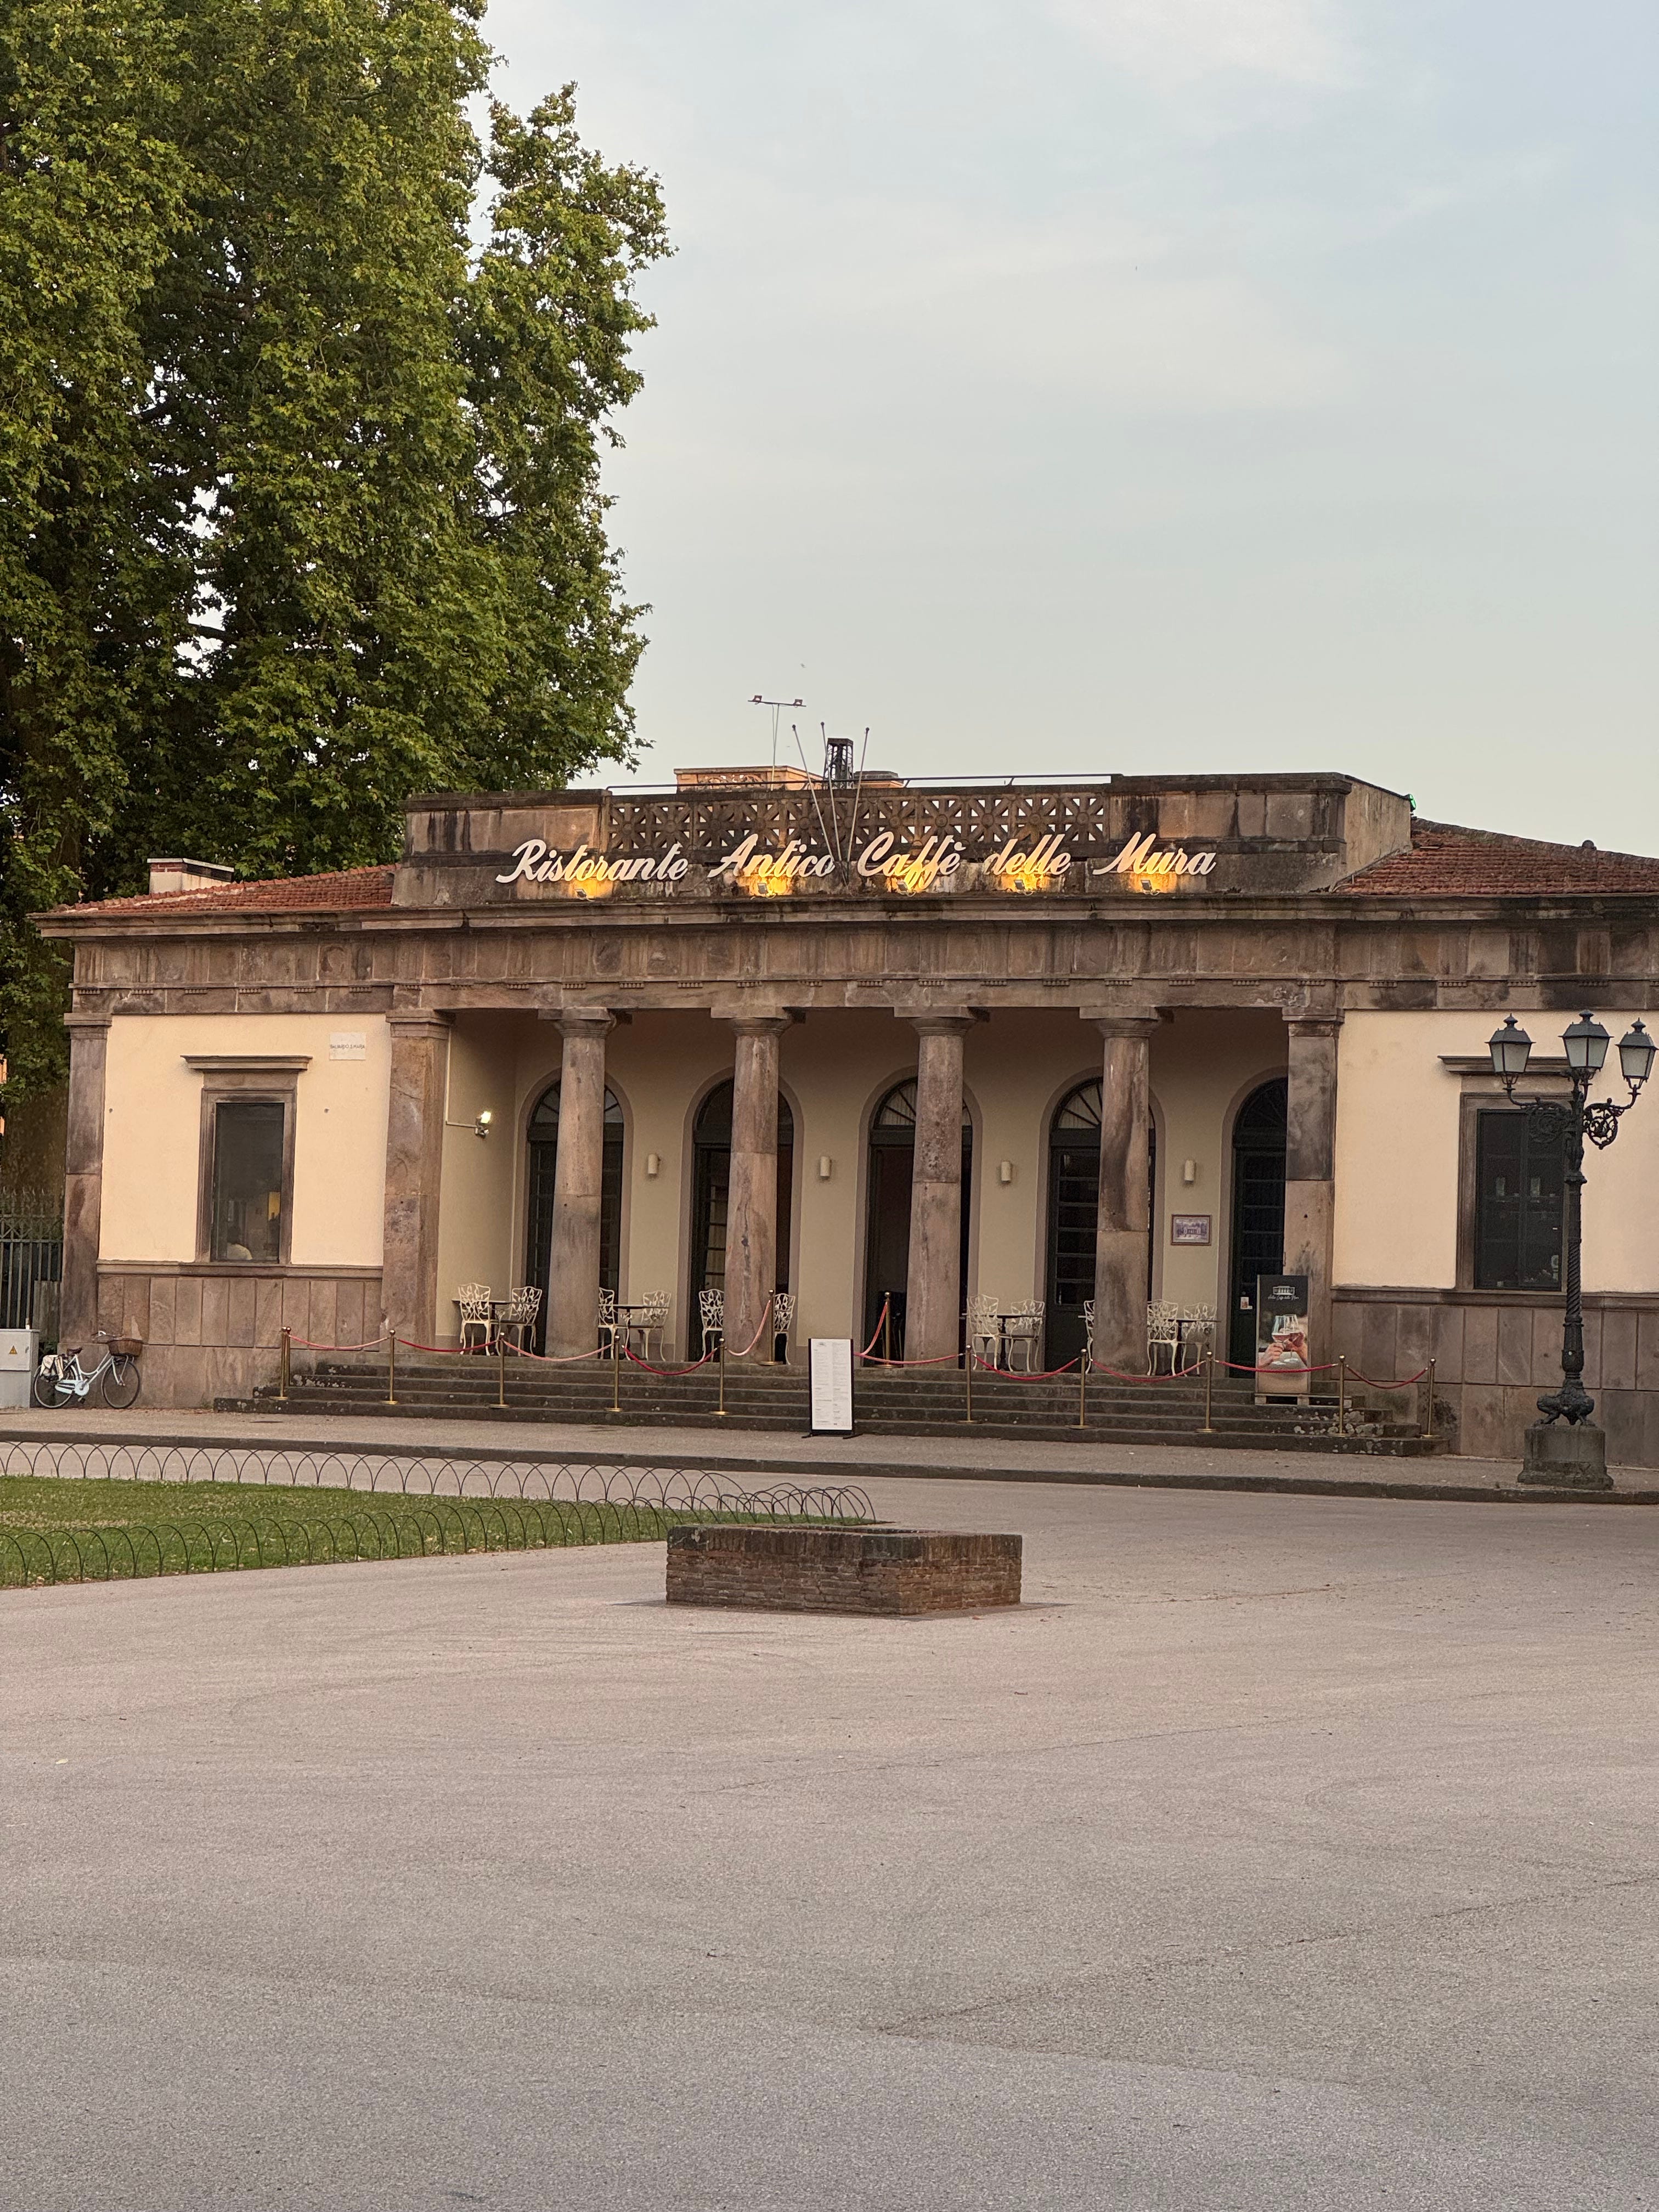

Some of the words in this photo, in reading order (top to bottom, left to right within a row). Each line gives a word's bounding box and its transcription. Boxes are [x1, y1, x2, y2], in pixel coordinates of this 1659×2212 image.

[495, 839, 689, 883] Ristorante
[708, 833, 836, 878] Antico
[857, 831, 967, 890] Caffè
[984, 833, 1071, 877] delle
[1092, 831, 1217, 876] Mura
